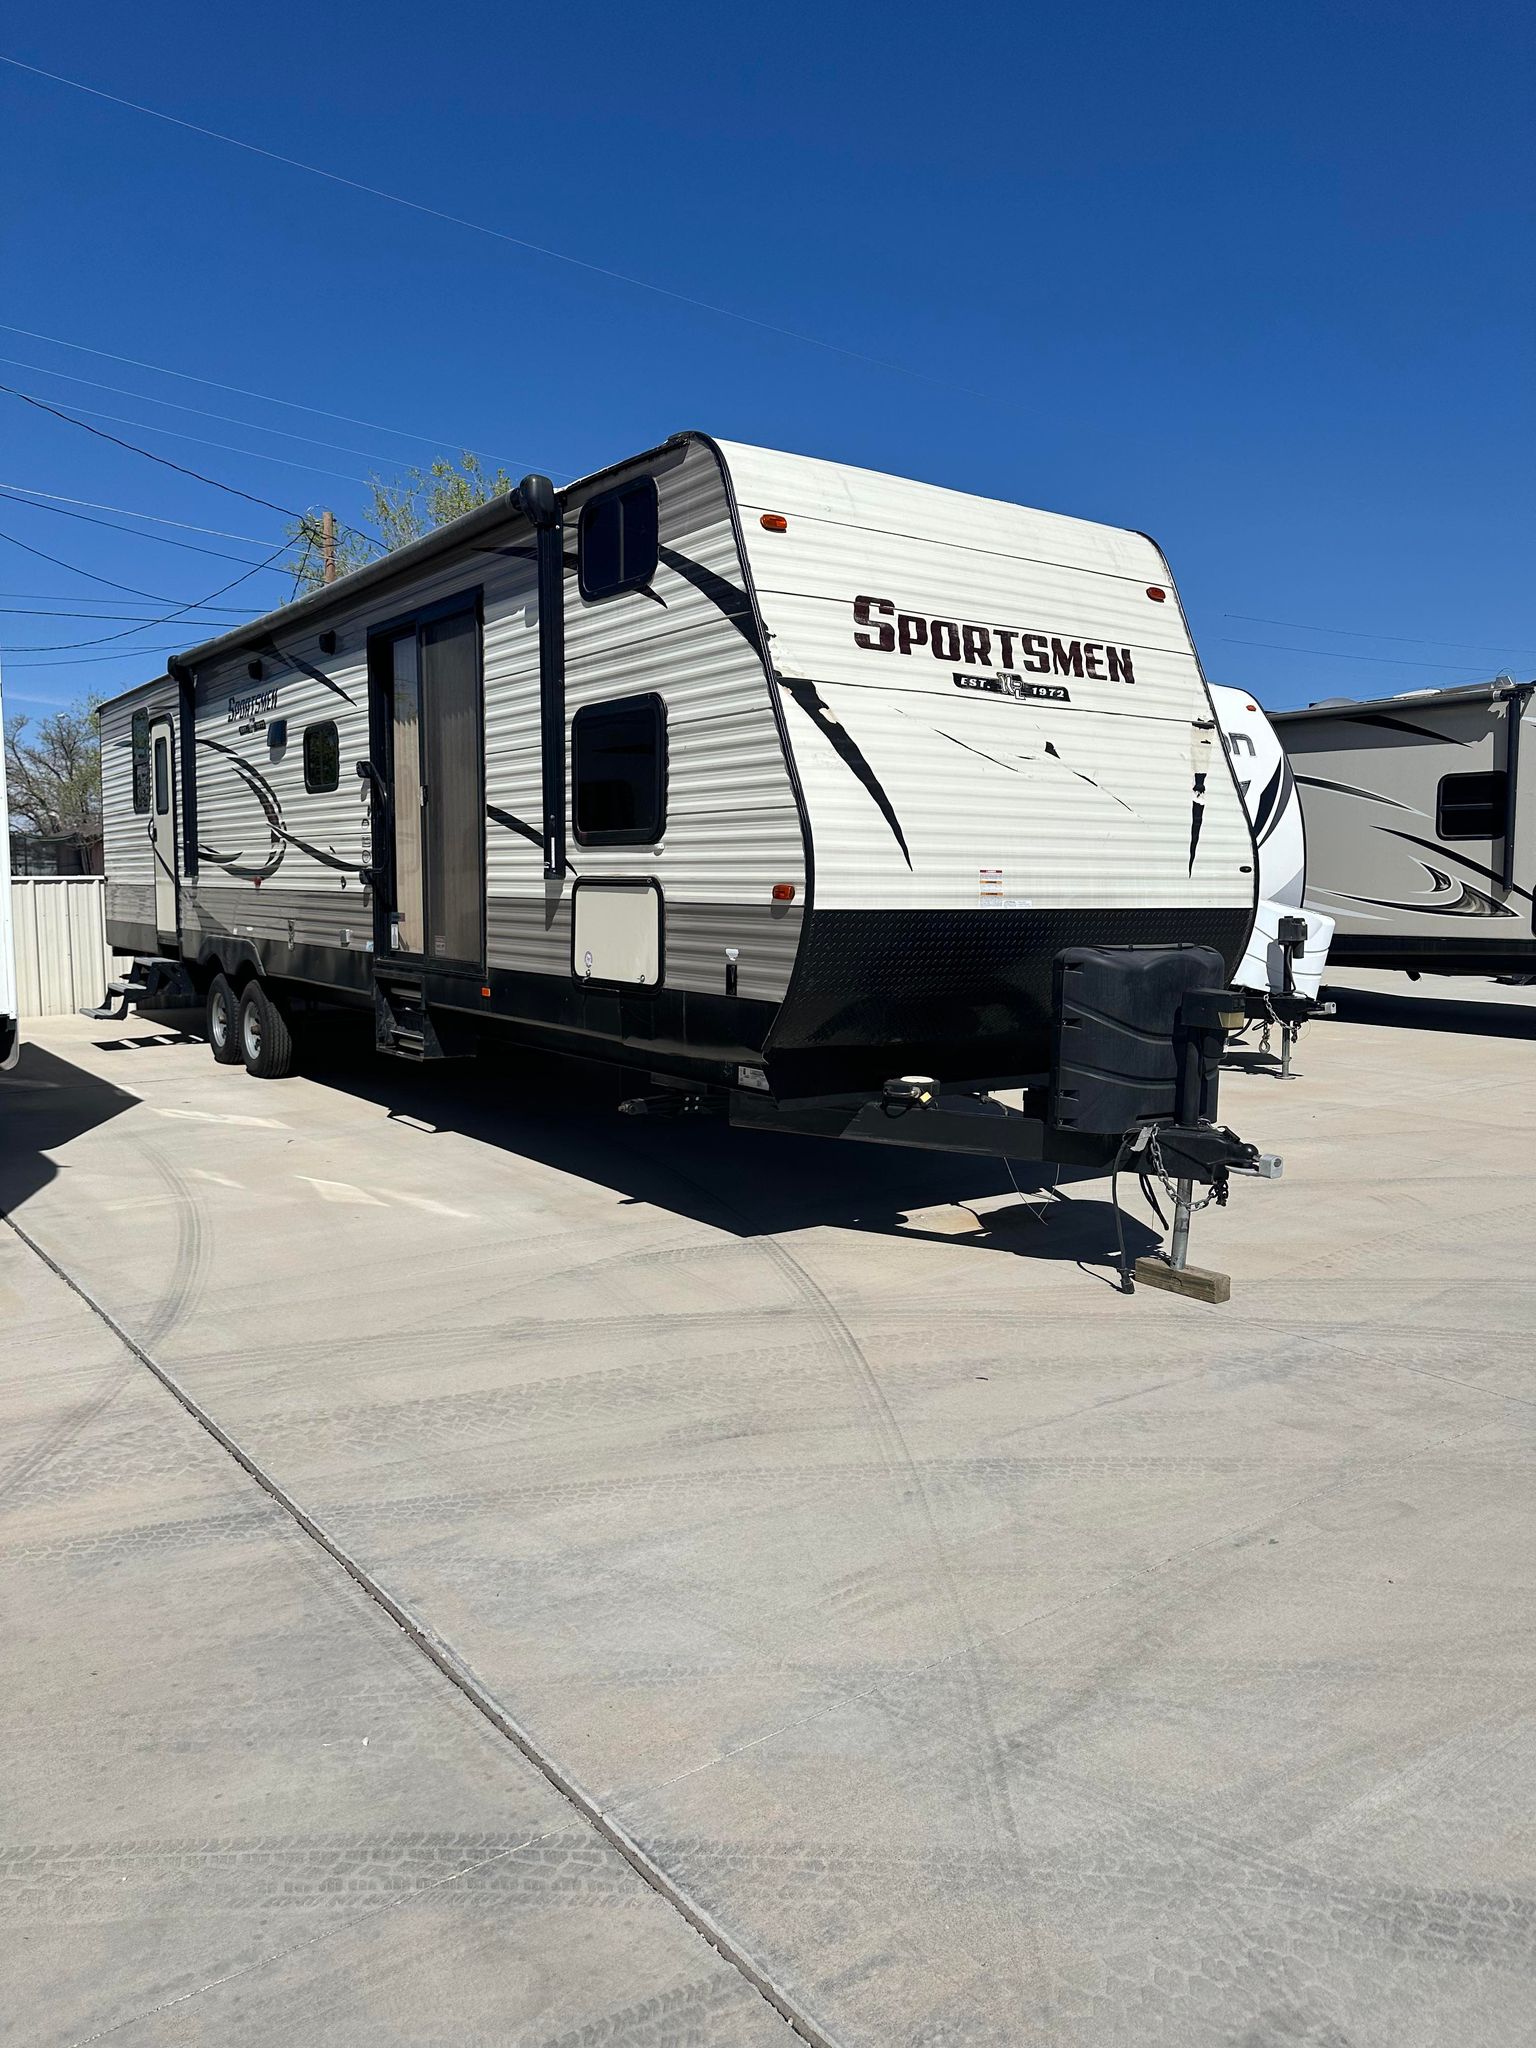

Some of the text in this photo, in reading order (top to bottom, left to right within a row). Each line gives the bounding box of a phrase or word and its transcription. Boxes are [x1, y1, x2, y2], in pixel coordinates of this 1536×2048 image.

[853, 594, 1135, 684] SPORTSMEN
[227, 687, 278, 722] SPORTSMEN
[960, 677, 991, 689] EST.
[1031, 687, 1065, 698] 1972
